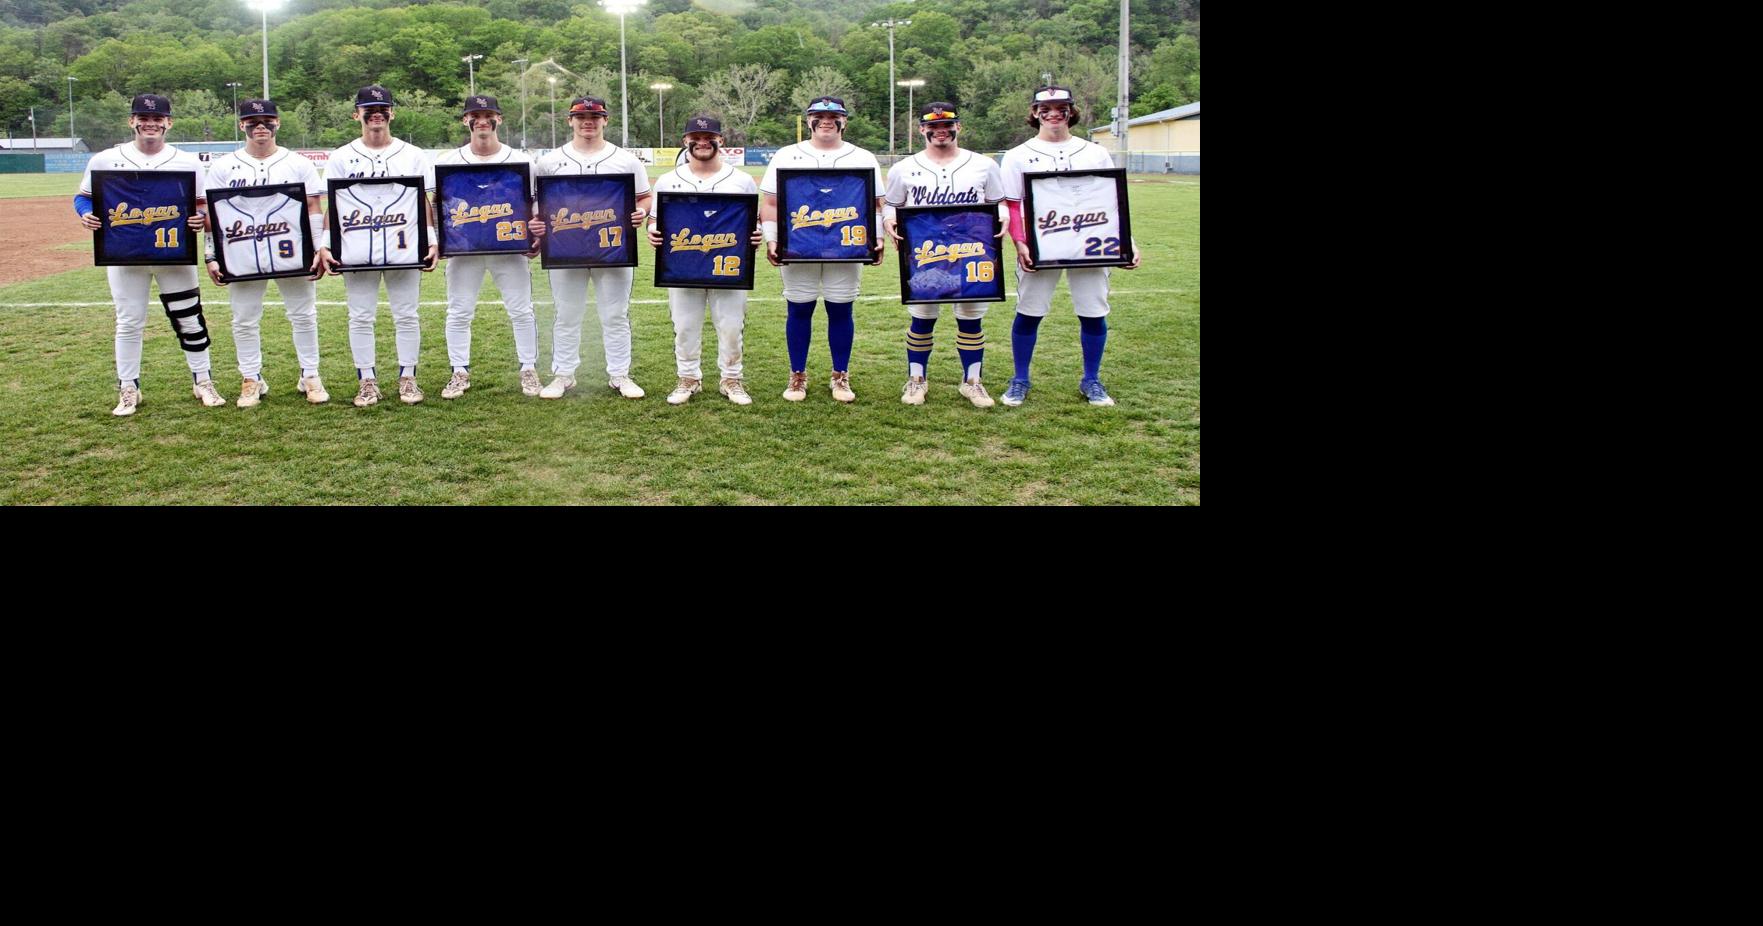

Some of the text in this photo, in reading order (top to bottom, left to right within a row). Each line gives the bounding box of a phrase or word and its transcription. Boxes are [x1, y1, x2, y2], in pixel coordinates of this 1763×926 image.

[911, 185, 979, 205] Wildcats
[108, 202, 180, 227] Logan
[342, 209, 407, 233] Logan
[450, 201, 514, 228] Logan
[550, 207, 617, 233] Logan
[790, 204, 859, 231] Logan
[1038, 210, 1109, 236] Logan
[154, 227, 179, 248] 11
[225, 220, 290, 244] Logan
[397, 230, 407, 249] 1
[495, 220, 527, 241] 23
[598, 226, 622, 248] 17
[670, 227, 738, 253] Logan
[840, 225, 867, 246] 19
[278, 239, 294, 258] 9
[914, 240, 986, 268] Logan
[1084, 236, 1120, 256] 22
[712, 255, 741, 276] 12
[965, 261, 994, 282] 16
